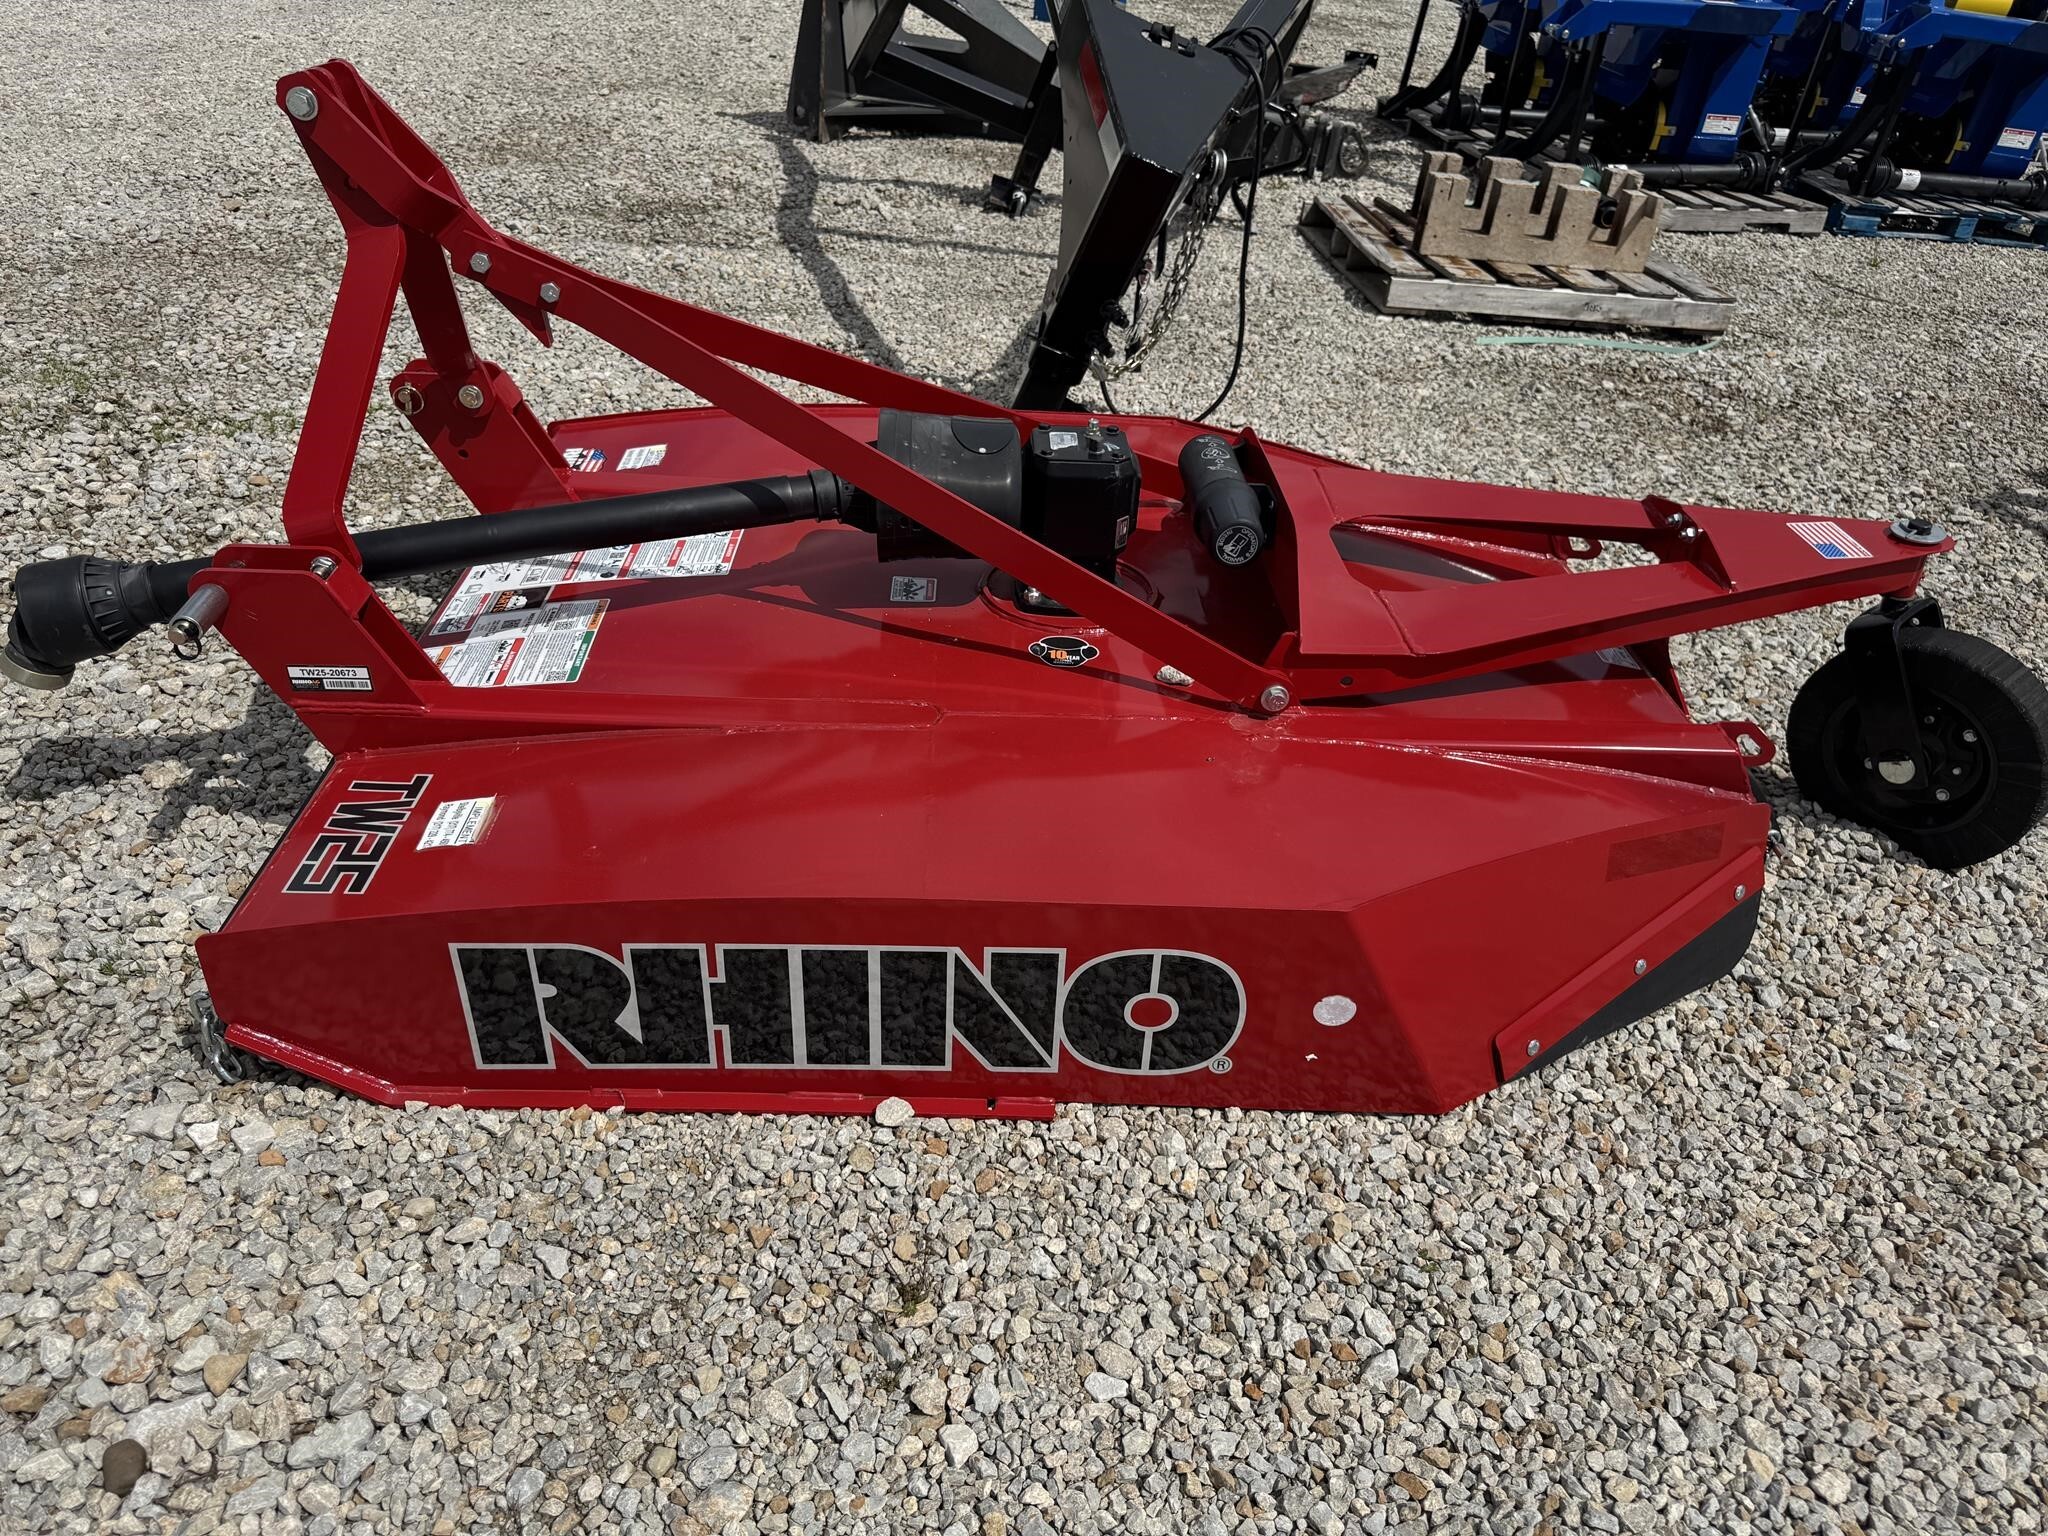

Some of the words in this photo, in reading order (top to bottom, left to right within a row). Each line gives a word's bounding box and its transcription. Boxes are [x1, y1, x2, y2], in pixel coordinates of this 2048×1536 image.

[299, 668, 358, 677] TW25-20673
[1048, 650, 1067, 659] 10
[281, 773, 435, 895] TW25
[459, 806, 483, 843] IMPLEMENT
[448, 943, 1247, 1076] RHINO
